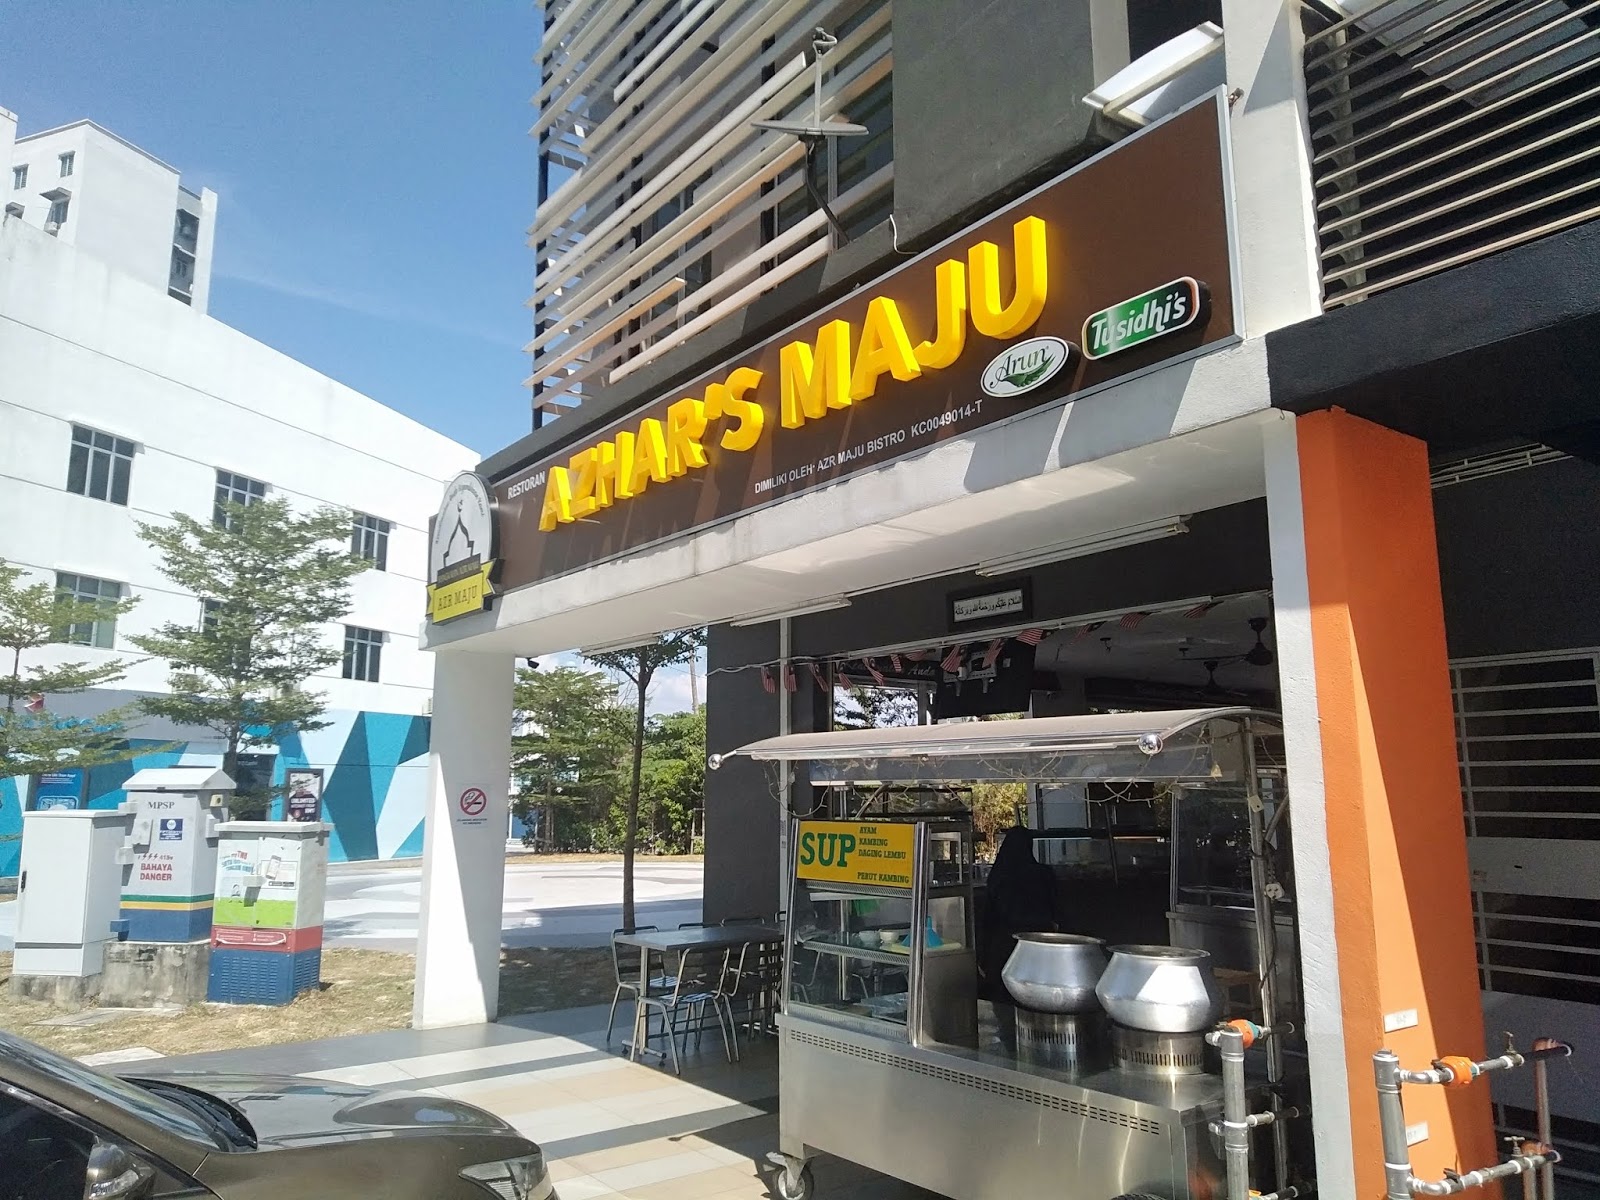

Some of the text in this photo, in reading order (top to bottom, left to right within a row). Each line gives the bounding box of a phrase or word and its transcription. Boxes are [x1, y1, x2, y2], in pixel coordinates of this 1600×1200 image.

[1091, 292, 1187, 350] Tusidhi's
[538, 215, 1048, 532] AZHAR'S MAJU
[989, 345, 1047, 389] Arun
[754, 471, 787, 494] DIMILIKI
[817, 455, 836, 472] AZR
[837, 443, 865, 465] MAJU
[867, 429, 906, 454] BISTRO
[911, 398, 984, 438] KC0049014-T
[507, 470, 546, 499] RESTORAN
[454, 584, 478, 606] MAJU
[148, 801, 175, 810] MPSP
[859, 827, 877, 835] AYAM
[800, 832, 856, 868] SUP
[858, 838, 888, 847] KAMBING
[858, 849, 906, 860] DAGING LEMBU
[140, 863, 173, 871] BAHAYA
[139, 872, 173, 881] DANGER
[857, 871, 910, 884] PERUT KAMBING
